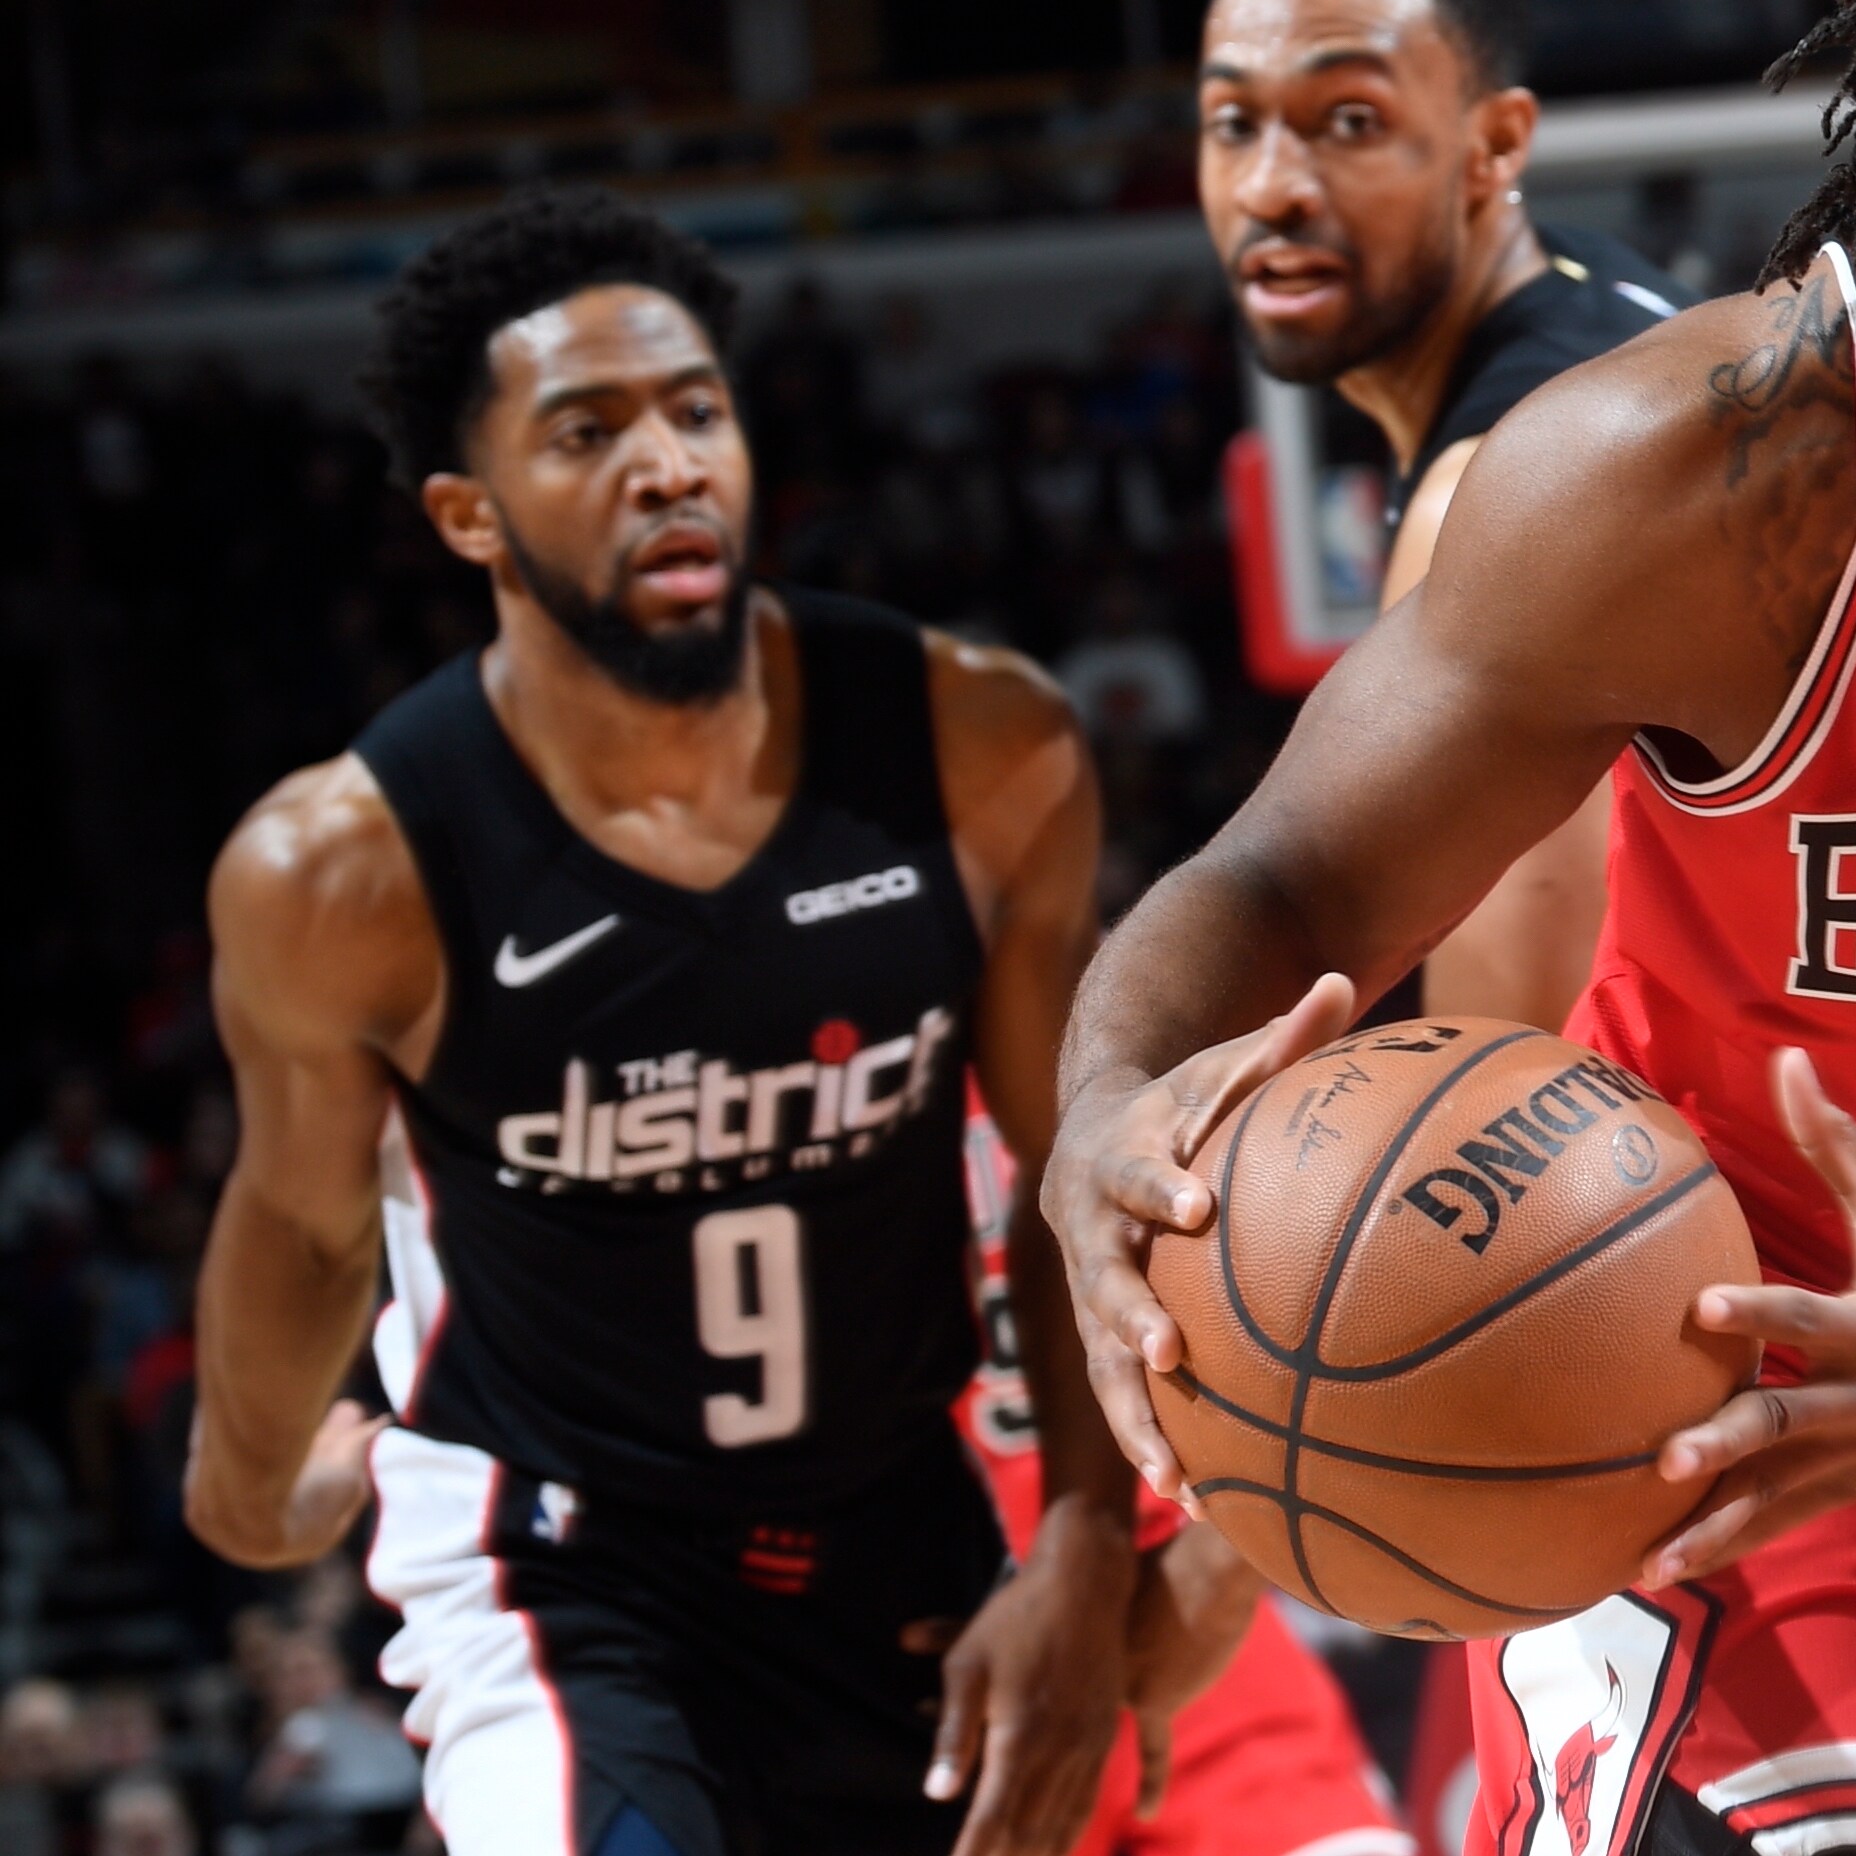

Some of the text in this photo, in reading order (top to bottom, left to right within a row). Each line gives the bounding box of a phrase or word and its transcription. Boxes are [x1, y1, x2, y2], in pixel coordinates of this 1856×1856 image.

[785, 864, 919, 926] GEICO
[616, 1049, 698, 1095] THE
[692, 1202, 808, 1449] 9
